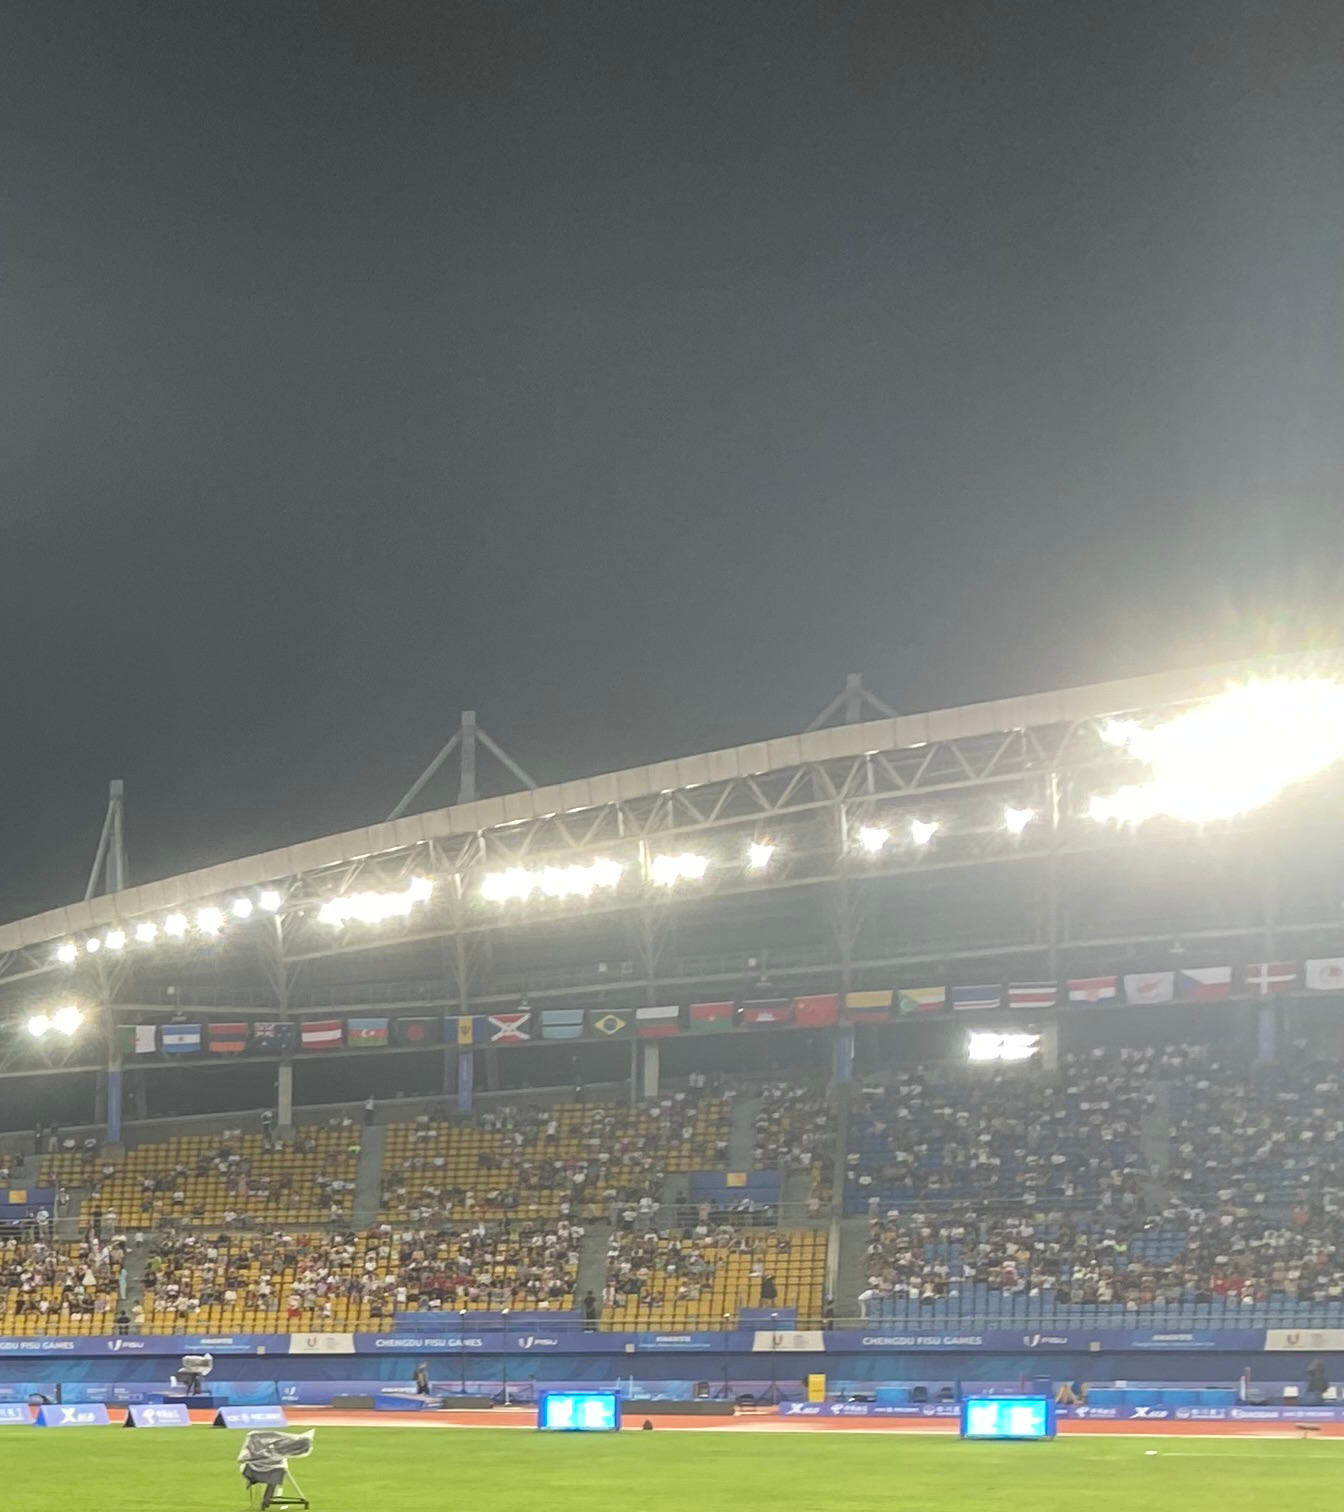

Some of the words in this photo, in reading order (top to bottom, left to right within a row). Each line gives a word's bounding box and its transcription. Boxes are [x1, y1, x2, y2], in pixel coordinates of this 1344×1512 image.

[20, 1341, 41, 1350] FISU
[42, 1341, 75, 1350] GAMES
[375, 1338, 422, 1348] CHENGDU
[424, 1338, 447, 1347] FISU
[448, 1338, 483, 1347] GAMES
[862, 1336, 915, 1346] CHENGDU
[917, 1336, 941, 1346] FISU
[943, 1336, 983, 1346] GAMES
